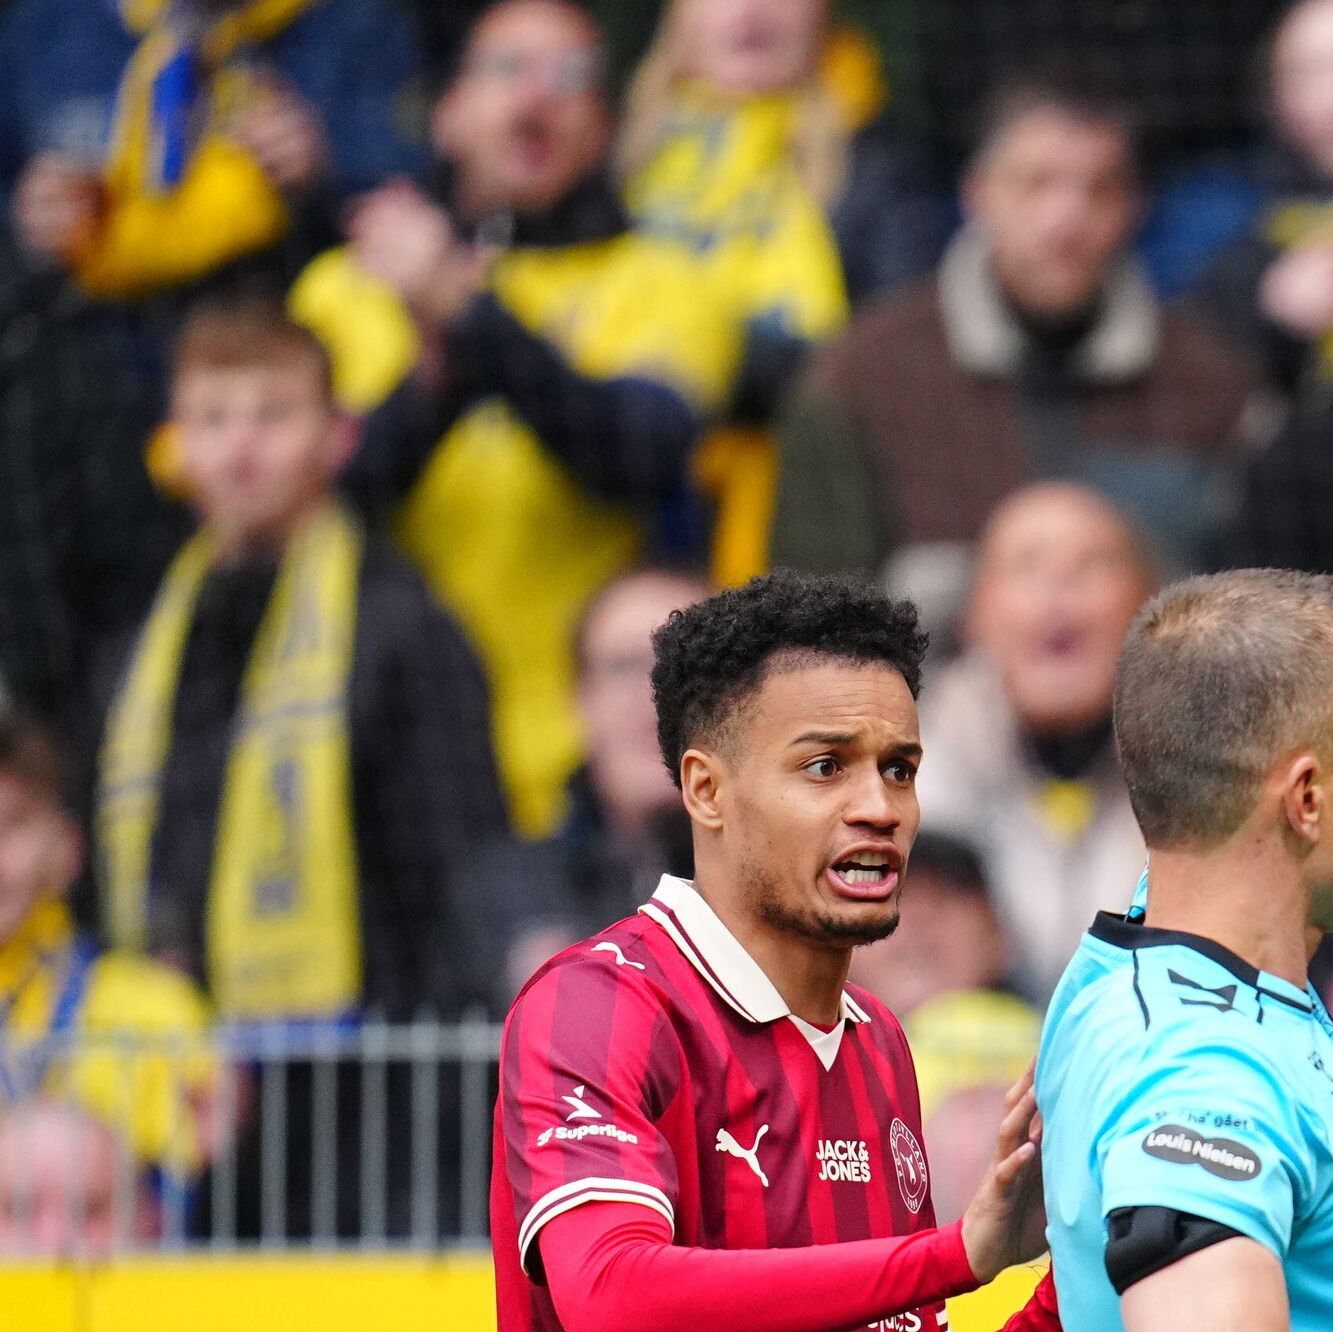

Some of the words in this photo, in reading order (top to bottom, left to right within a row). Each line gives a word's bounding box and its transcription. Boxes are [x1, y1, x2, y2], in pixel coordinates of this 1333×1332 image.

[555, 1123, 638, 1145] Superliga
[1146, 1132, 1193, 1153] Louis
[1191, 1140, 1256, 1174] Nielsen
[818, 1160, 872, 1183] JONES
